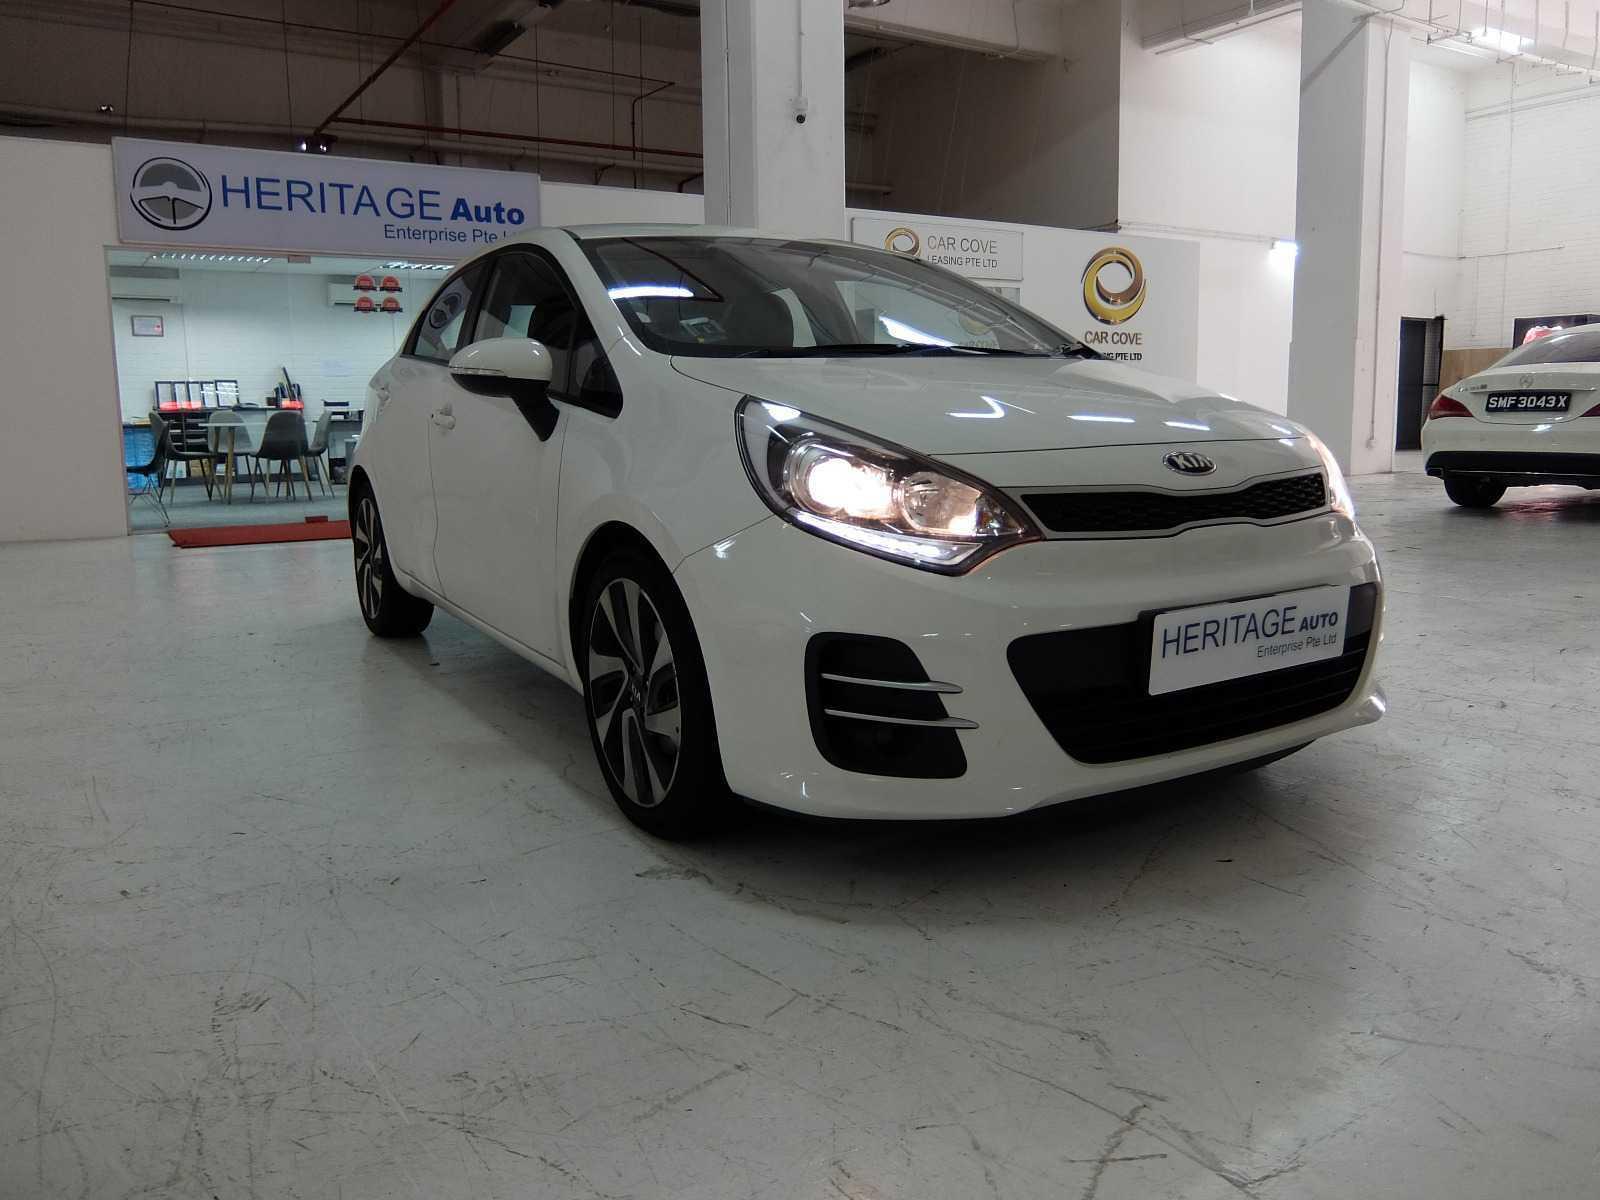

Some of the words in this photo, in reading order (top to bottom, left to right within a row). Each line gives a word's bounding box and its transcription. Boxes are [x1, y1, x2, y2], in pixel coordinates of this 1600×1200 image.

[221, 174, 443, 221] HERITAGE
[449, 198, 526, 226] Auto
[384, 224, 468, 244] Enterprise
[472, 229, 499, 243] Pte
[927, 235, 957, 251] CAR
[960, 238, 998, 254] COVE
[965, 257, 981, 267] PTE
[982, 258, 998, 268] LTD
[1084, 330, 1109, 344] CAR
[1111, 331, 1143, 345] COVE
[1115, 352, 1129, 361] PTE
[1129, 352, 1143, 361] LTD
[1488, 396, 1517, 408] SMF
[1519, 396, 1555, 408] 3043
[1558, 395, 1568, 408] X
[1161, 606, 1298, 658] HERITAGE
[1300, 612, 1339, 633] AUTO
[1257, 639, 1304, 659] Enterprise
[1306, 636, 1321, 649] Pte
[1323, 633, 1337, 645] Ltd
